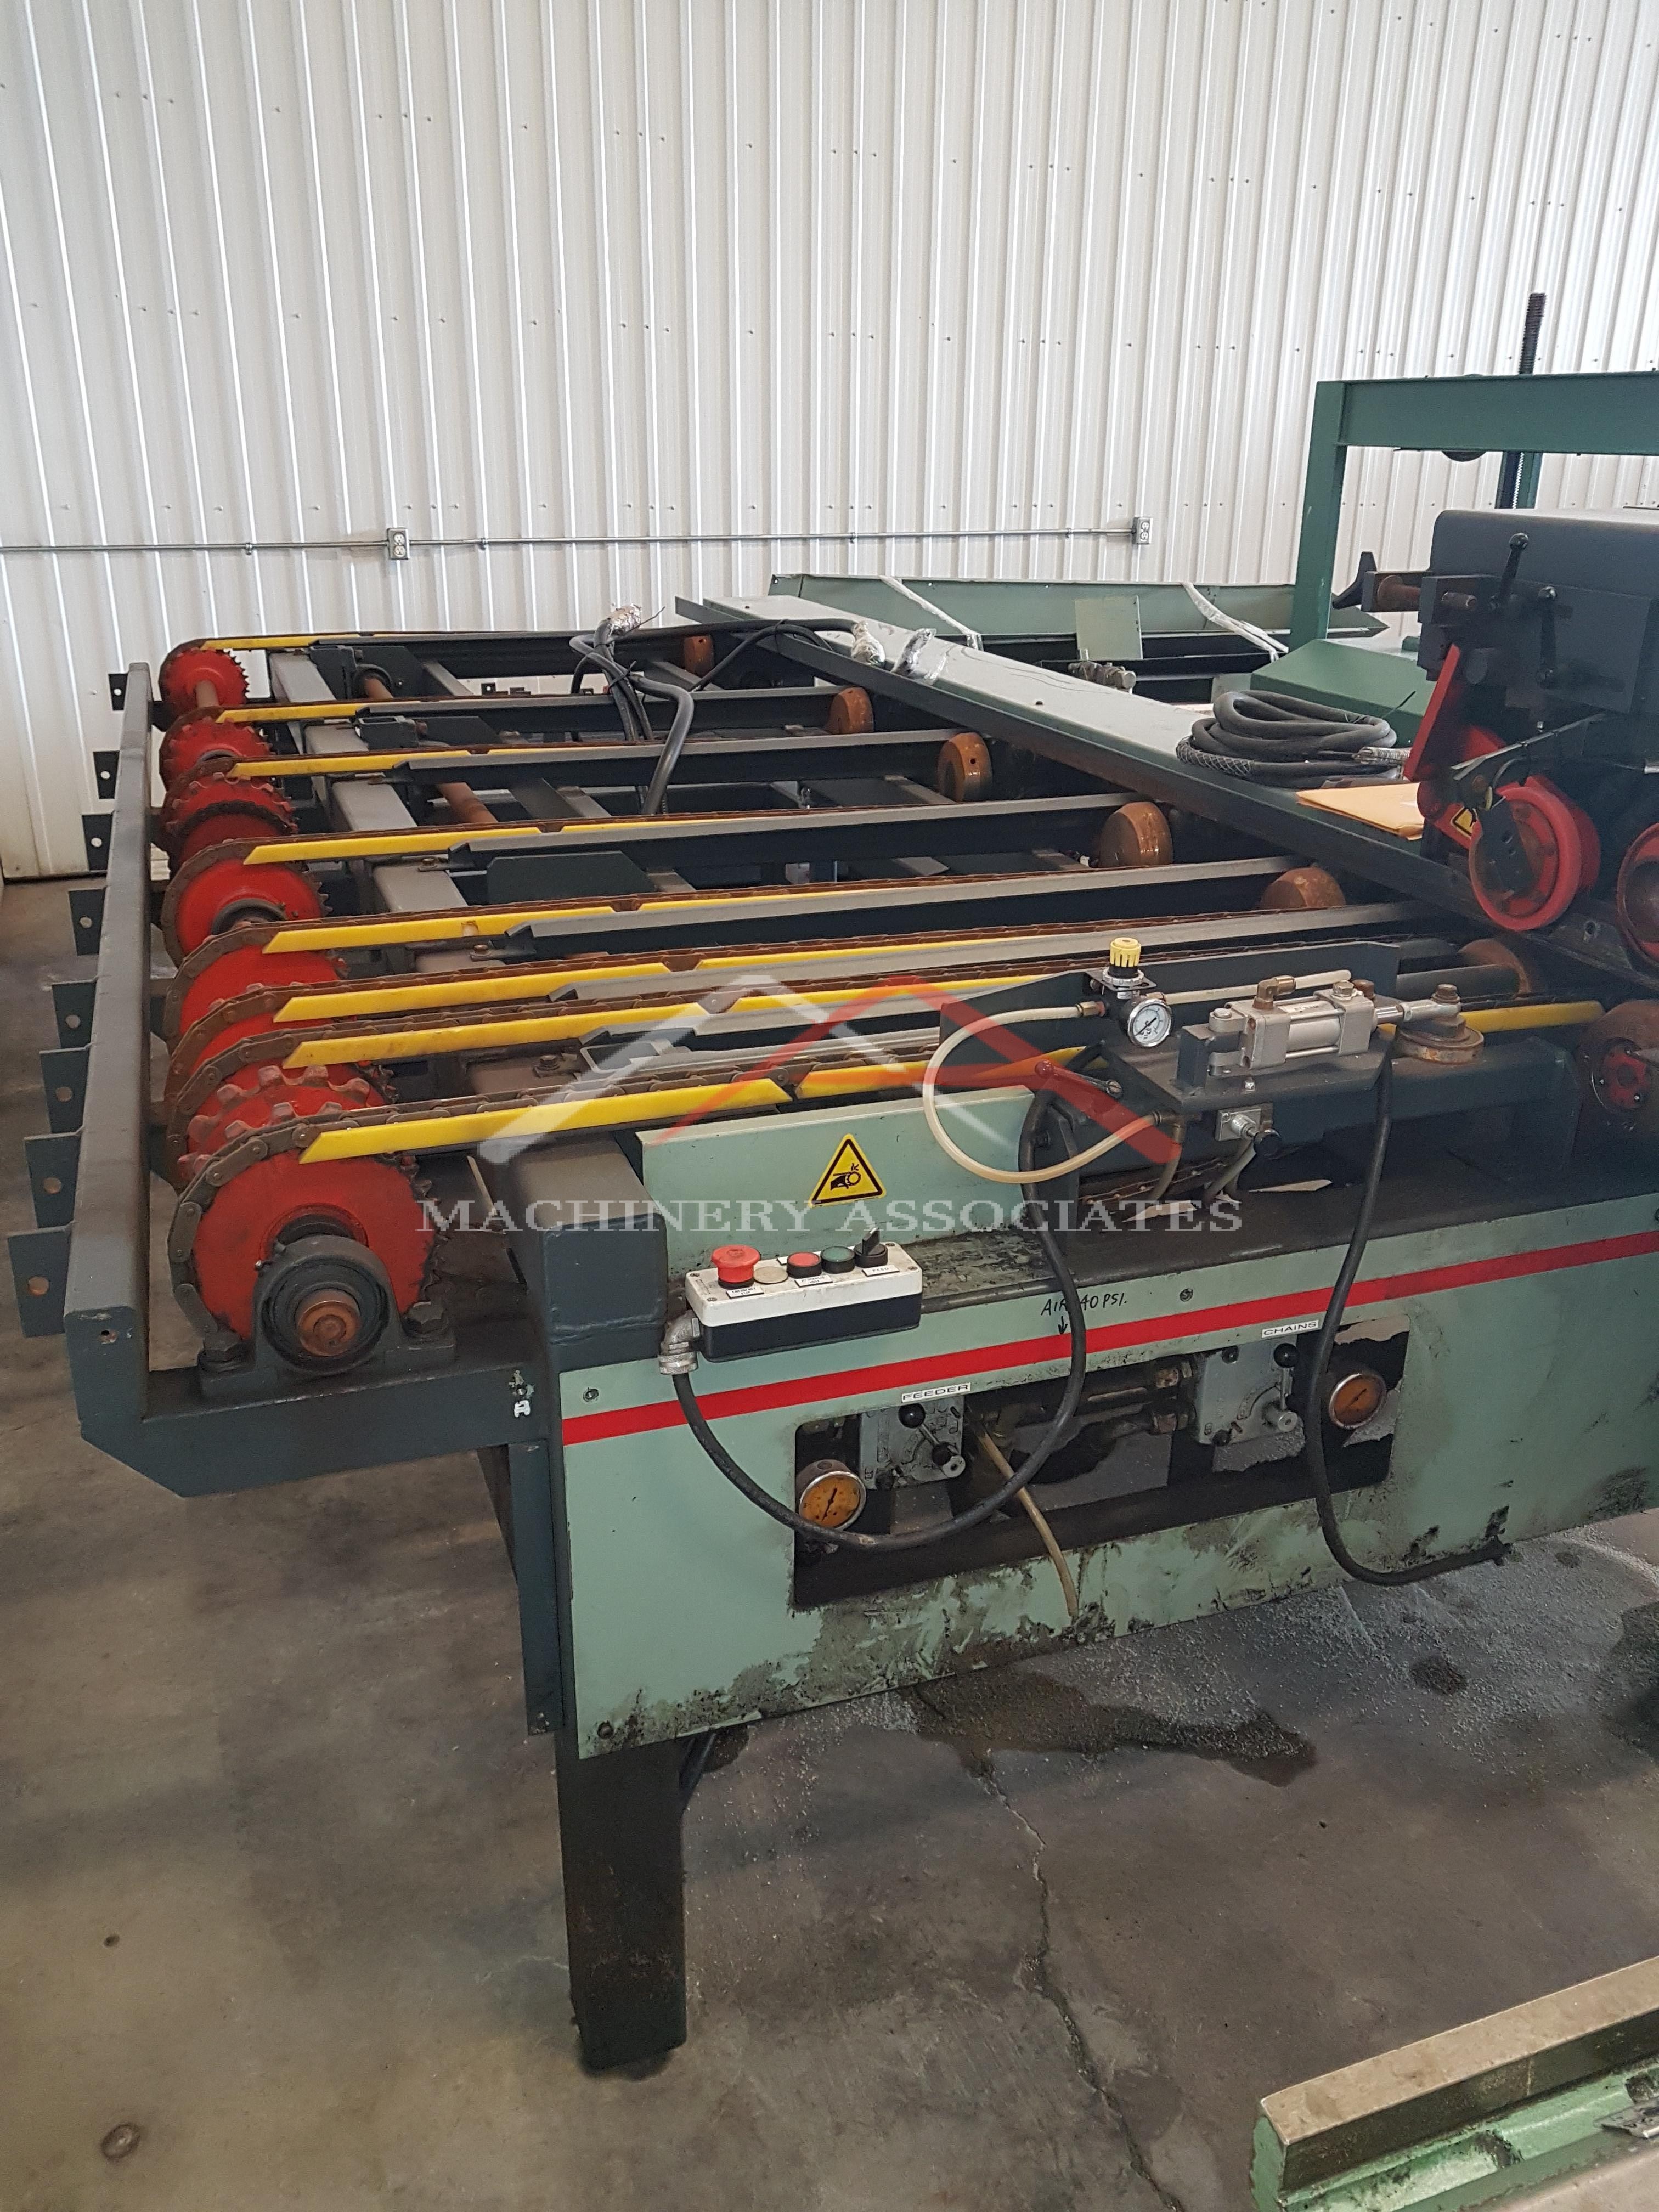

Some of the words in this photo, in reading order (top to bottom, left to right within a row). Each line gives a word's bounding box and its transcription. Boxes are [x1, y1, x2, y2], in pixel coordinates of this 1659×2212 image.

[1040, 1298, 1068, 1316] AIR
[1263, 1322, 1317, 1335] CHAINS
[902, 1384, 968, 1401] FEEDER
